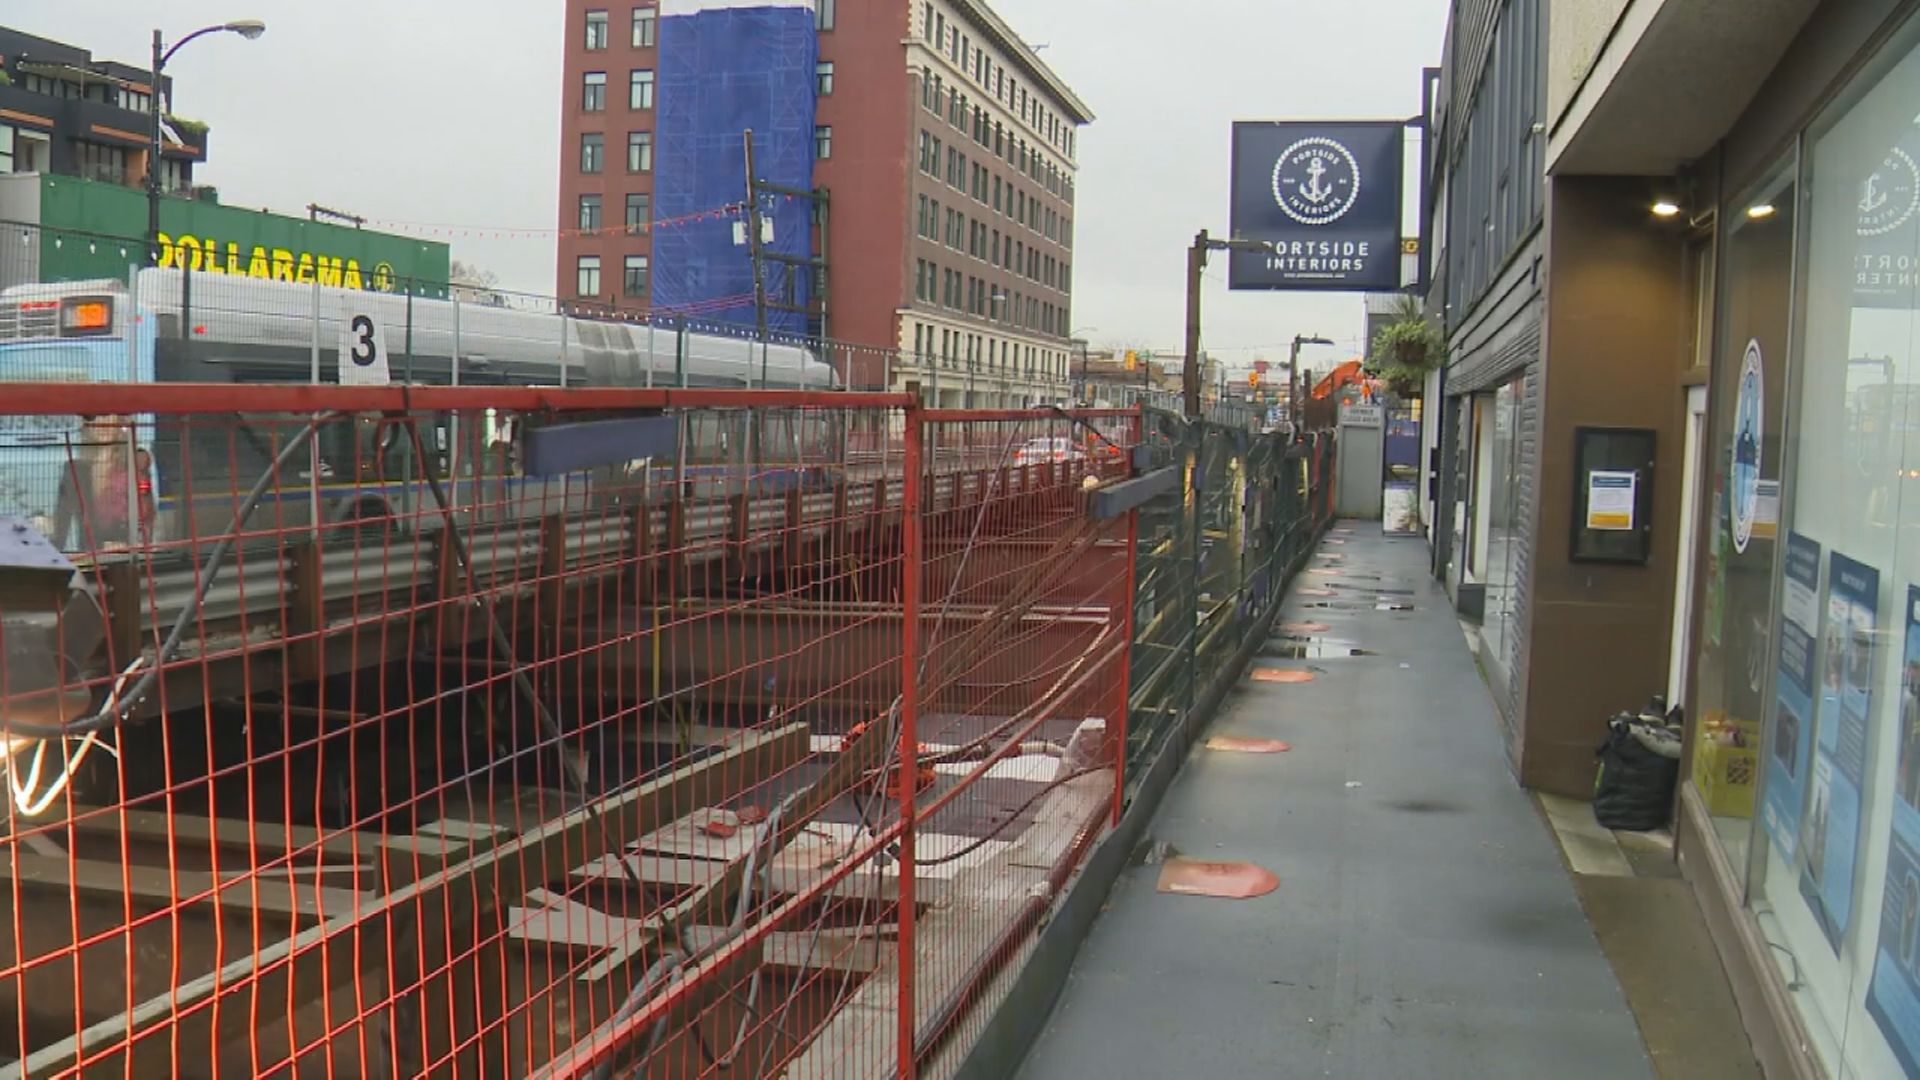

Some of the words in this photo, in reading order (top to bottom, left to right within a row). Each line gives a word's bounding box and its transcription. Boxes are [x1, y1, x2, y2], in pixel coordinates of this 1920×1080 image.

[1292, 149, 1341, 164] PORTSIDE
[1289, 196, 1342, 214] INTERIORS
[1266, 258, 1363, 270] INTERIORS
[351, 315, 376, 367] 3
